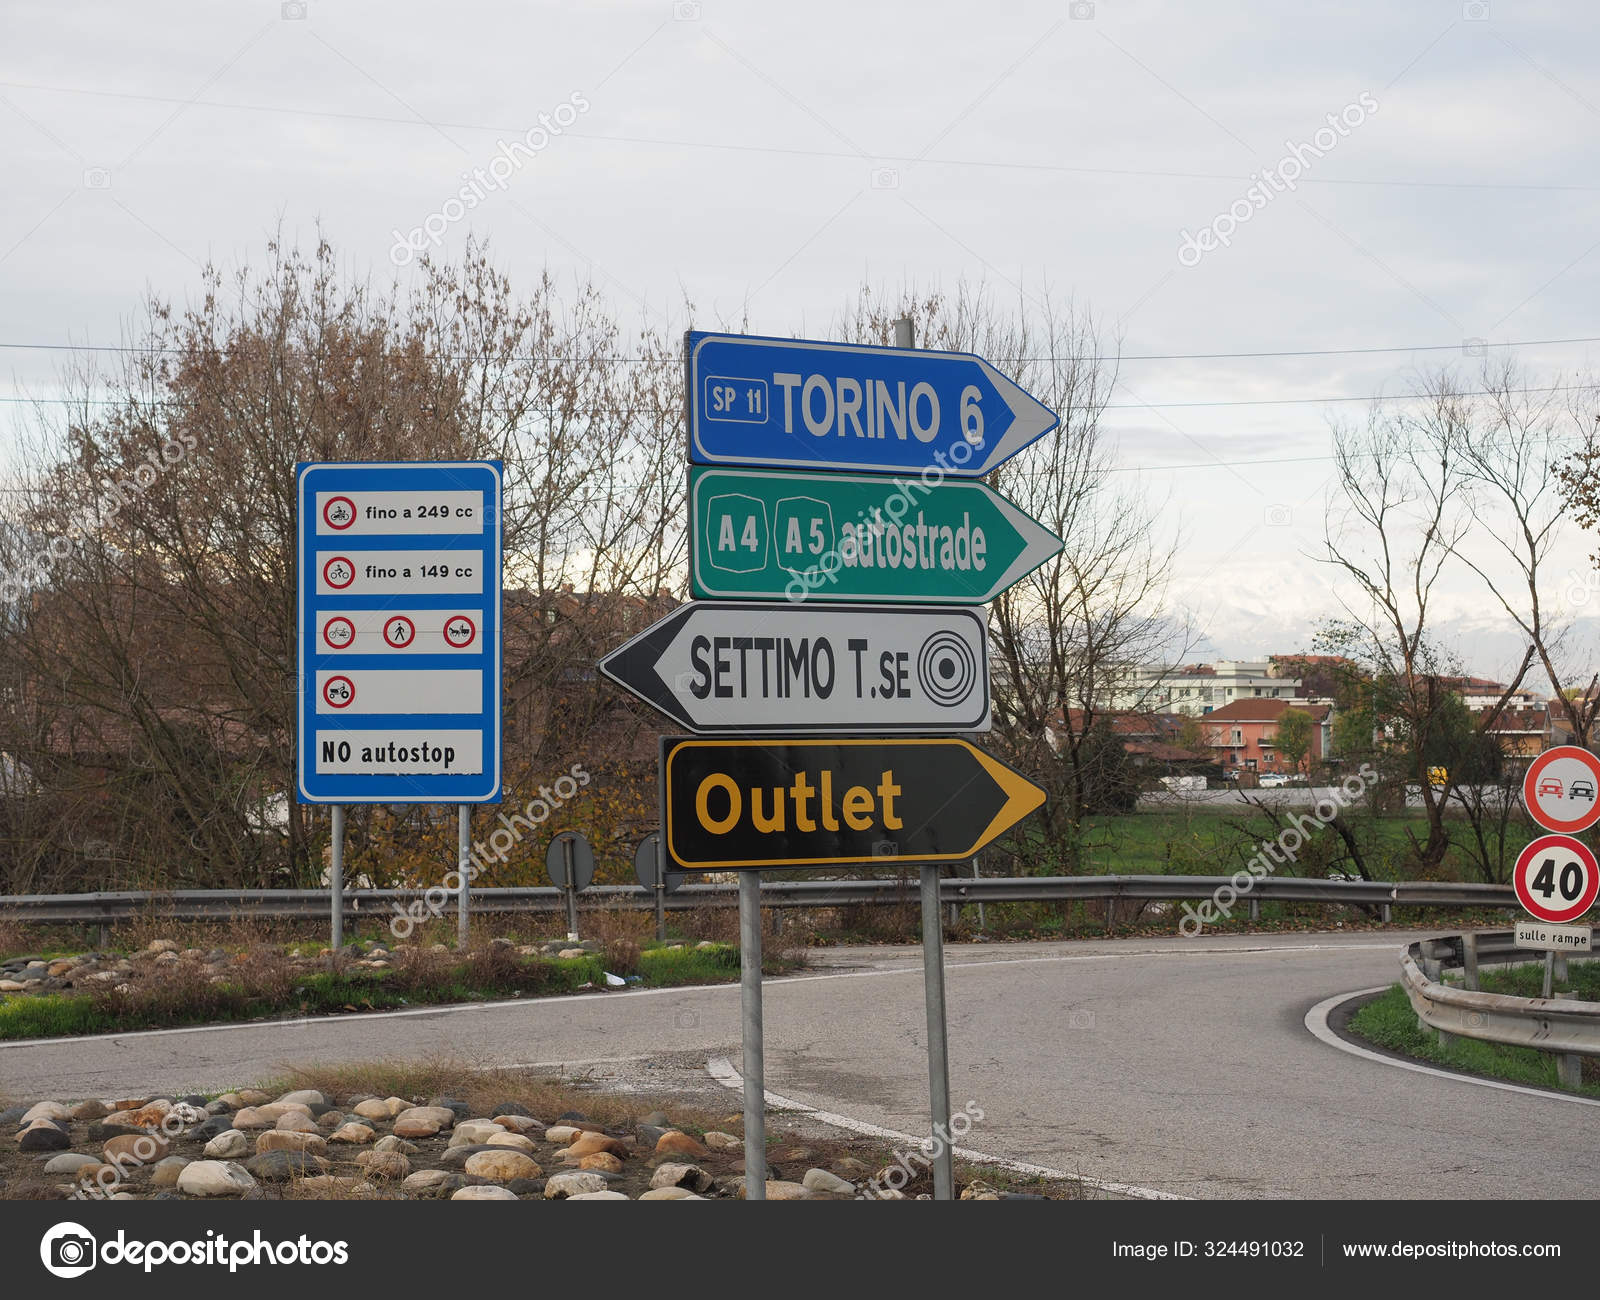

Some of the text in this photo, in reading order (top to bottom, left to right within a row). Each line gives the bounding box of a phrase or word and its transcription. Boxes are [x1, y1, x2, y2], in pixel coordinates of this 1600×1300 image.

[712, 386, 762, 413] SP 11
[773, 372, 985, 445] TORINO 6
[366, 506, 473, 519] fino a 249 cc
[841, 507, 987, 571] autostrade
[366, 565, 473, 578] fino a 149 cc
[690, 635, 835, 700] SETTIMO
[322, 741, 455, 768] NO autostop
[695, 770, 904, 835] Outlet
[1531, 859, 1583, 901] 40
[1519, 930, 1587, 947] sulle rampe
